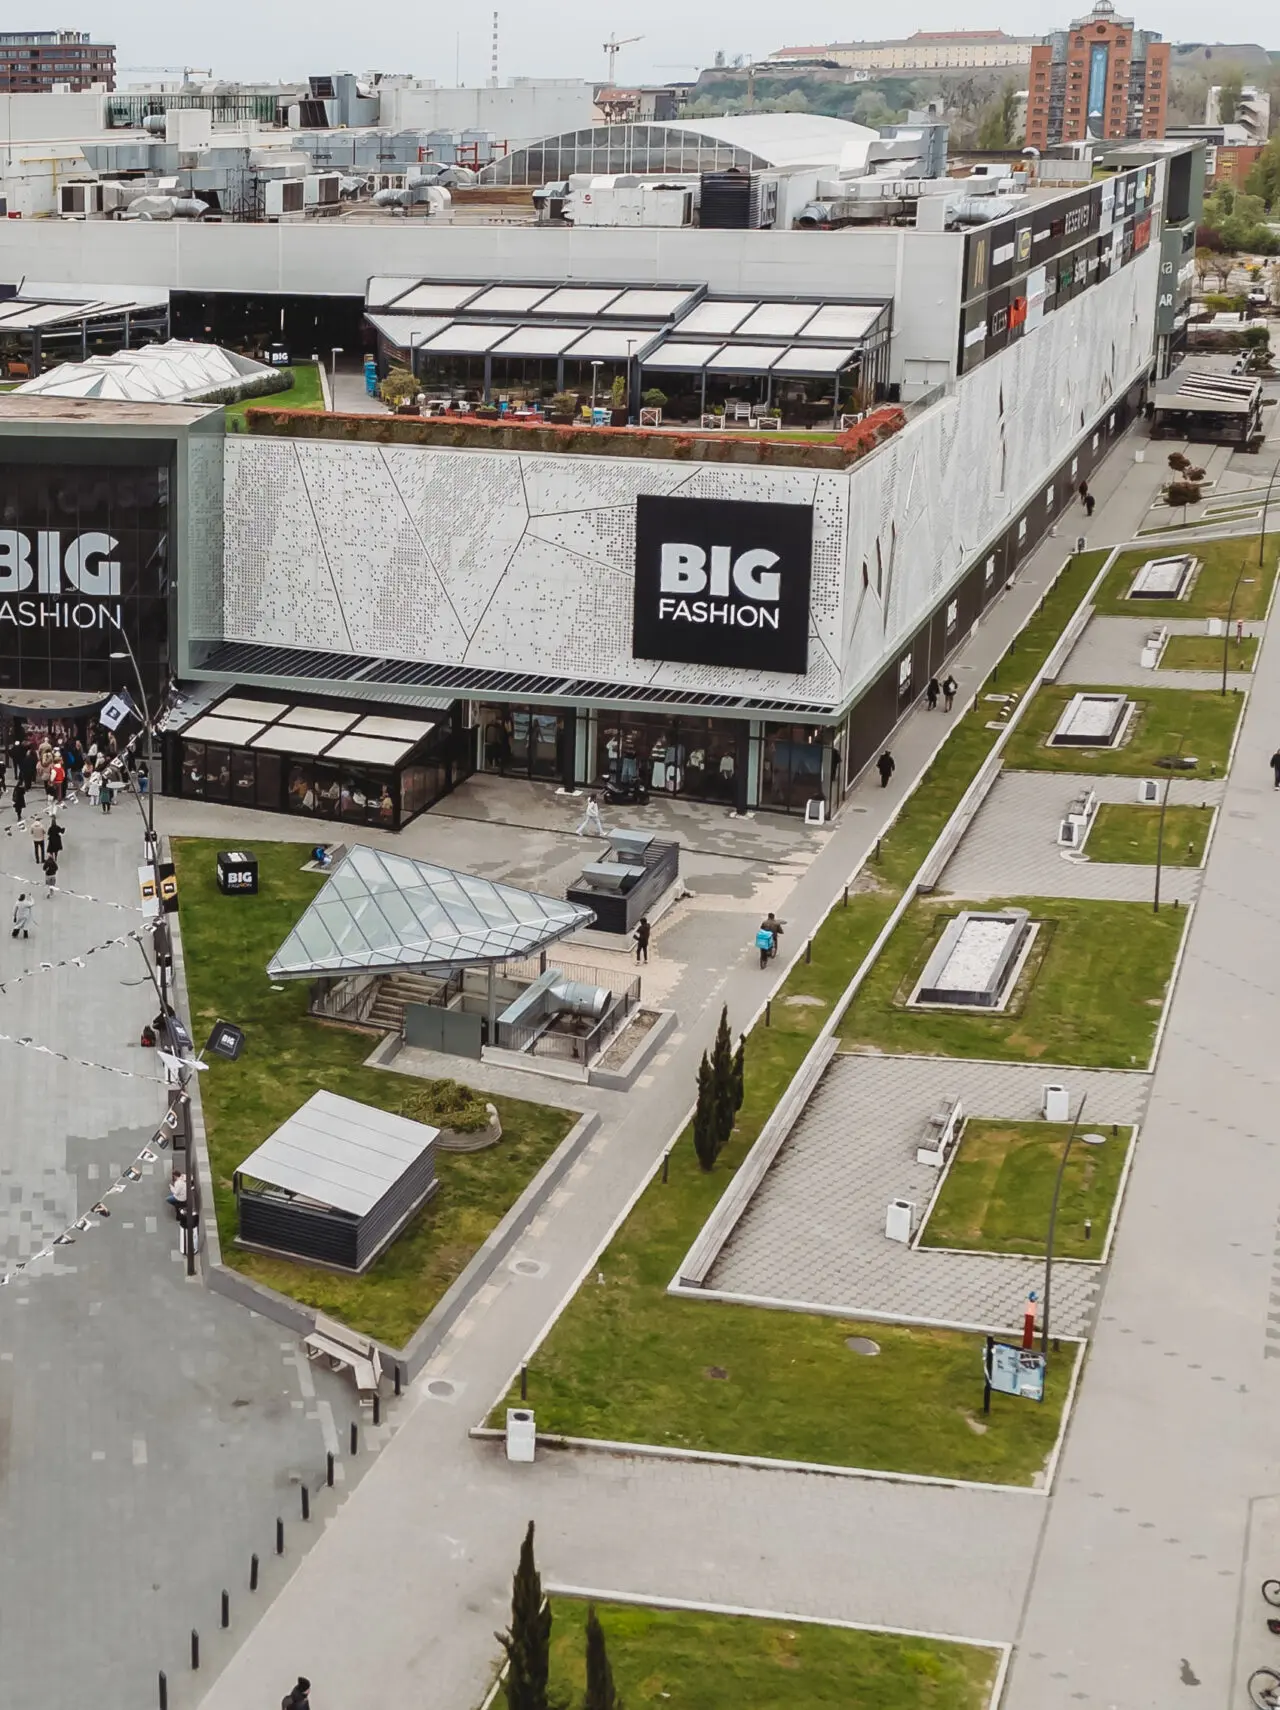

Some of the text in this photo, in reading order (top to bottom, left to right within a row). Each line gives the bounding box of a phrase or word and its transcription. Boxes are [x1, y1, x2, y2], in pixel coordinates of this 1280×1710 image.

[660, 543, 781, 601] BIG
[658, 598, 780, 630] FASHION
[228, 872, 252, 883] BIG
